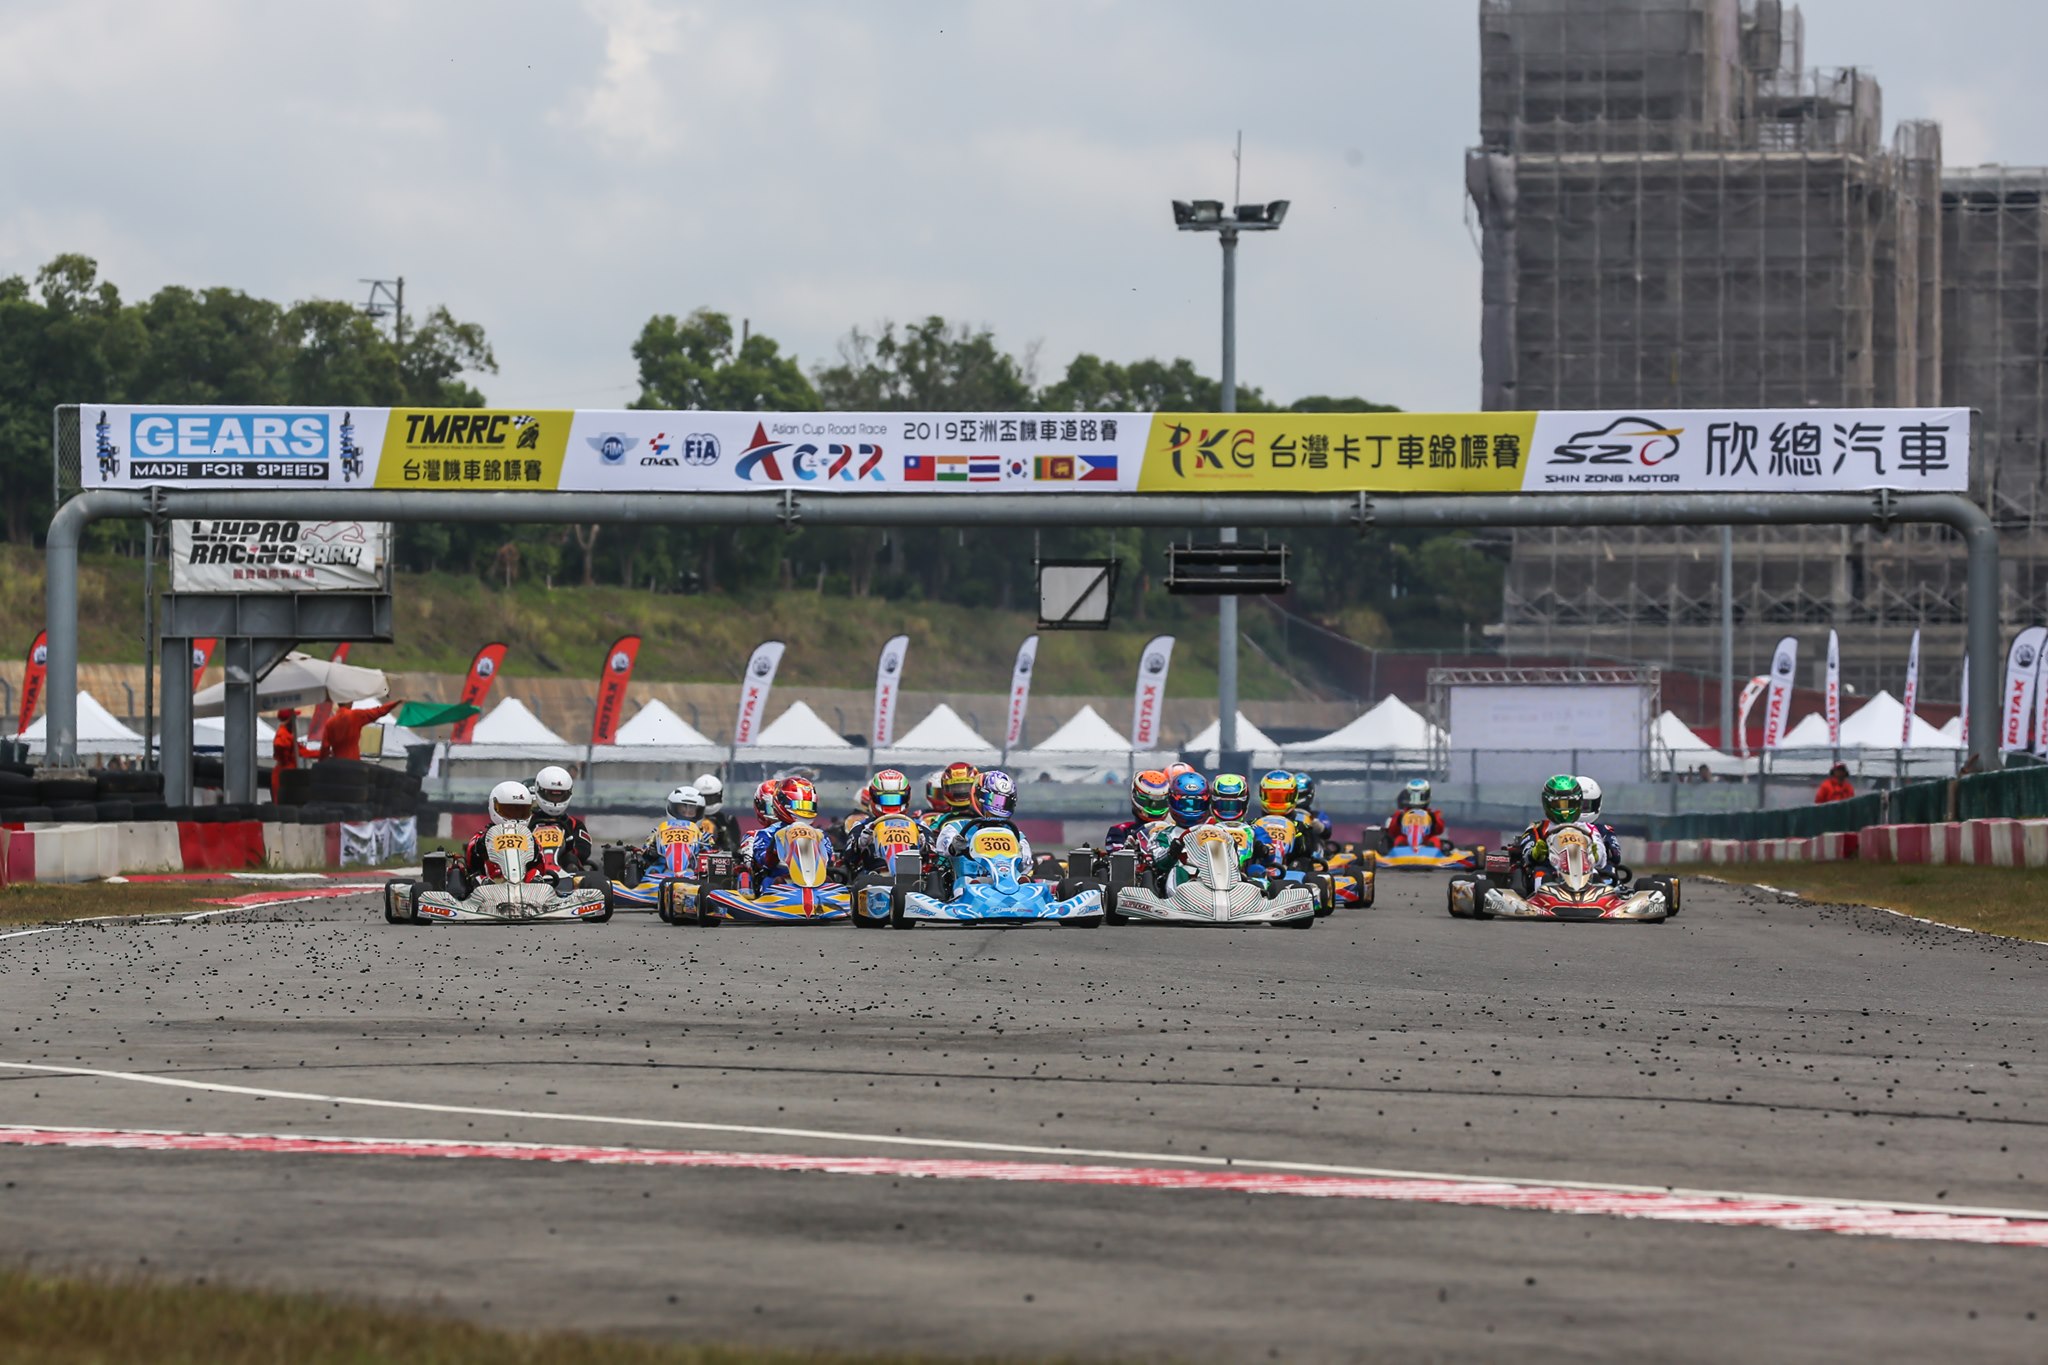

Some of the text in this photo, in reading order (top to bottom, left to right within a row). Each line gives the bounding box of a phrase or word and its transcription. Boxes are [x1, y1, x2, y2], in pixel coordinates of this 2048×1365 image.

[135, 417, 325, 456] GEARS
[405, 415, 511, 444] TMRRC
[771, 423, 888, 436] Asian Cup Road Race
[1269, 433, 1521, 470] 台灣卡丁車錦標賽
[1706, 421, 1950, 476] 欣總汽車
[134, 463, 324, 477] MADE FOR SPEED
[403, 458, 542, 482] 台灣機車錦標賽
[1545, 474, 1680, 483] SHIN ZONG MOTOR
[189, 543, 362, 566] RACING PARK
[1137, 684, 1156, 743] ROTAX
[1766, 686, 1785, 747] ROTAX
[2007, 679, 2025, 745] ROTAX
[497, 839, 523, 850] 287
[666, 833, 689, 844] 238
[886, 833, 910, 844] 400
[984, 841, 1011, 851] 300
